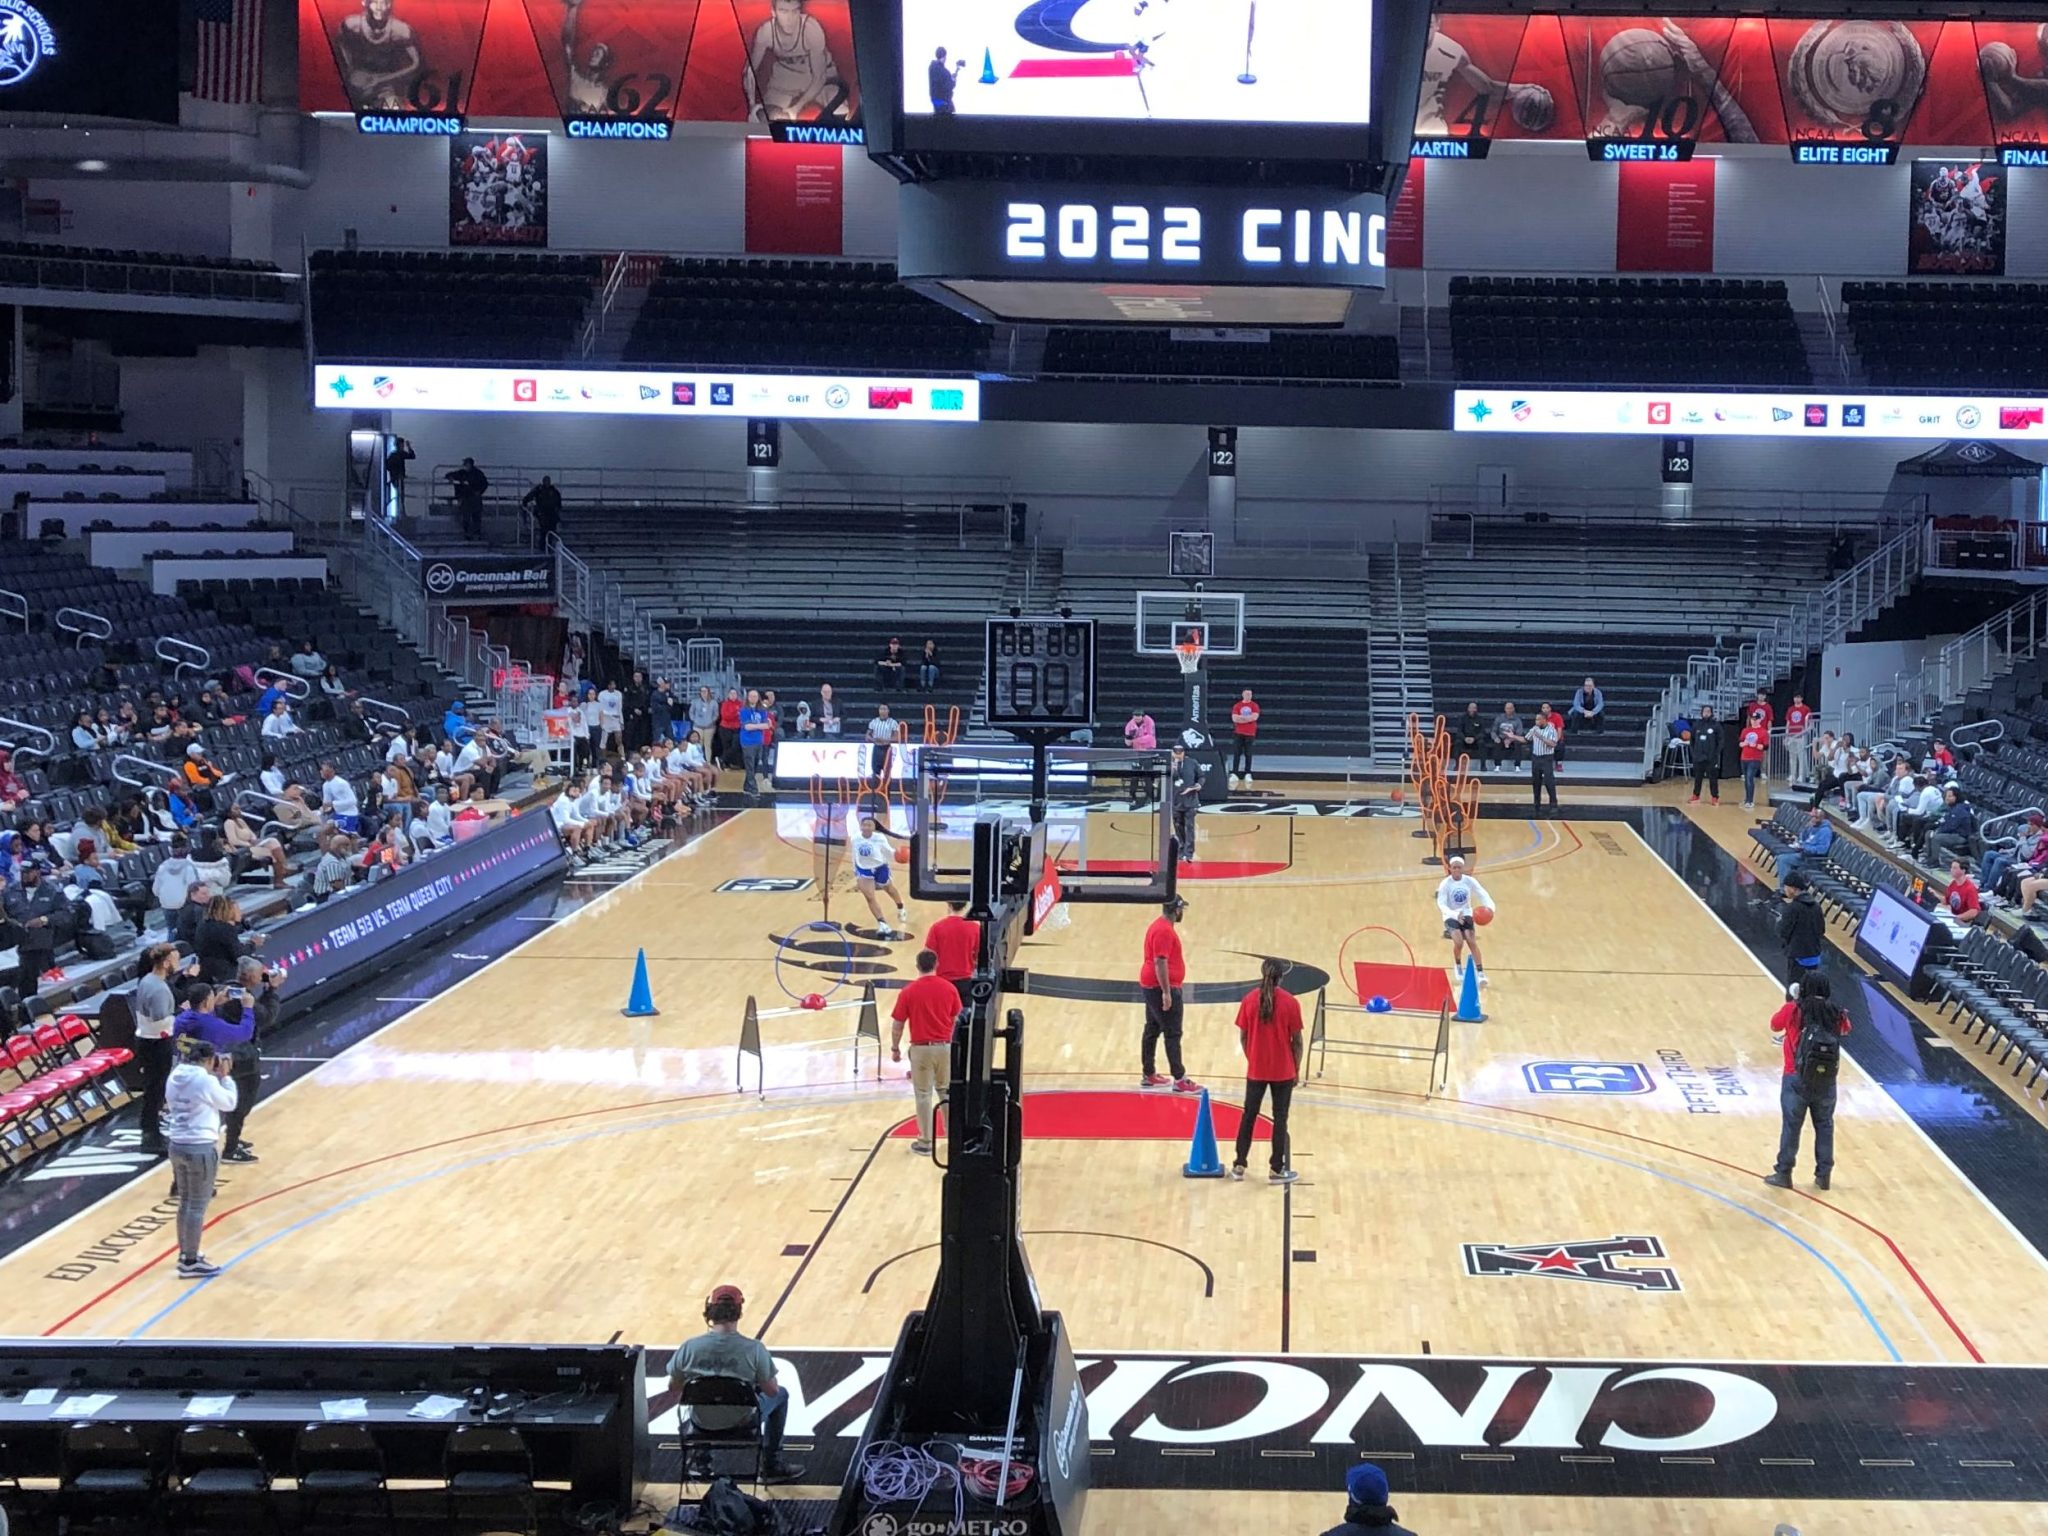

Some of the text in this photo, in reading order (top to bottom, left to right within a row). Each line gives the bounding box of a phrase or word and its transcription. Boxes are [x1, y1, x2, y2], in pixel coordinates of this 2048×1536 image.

[23, 5, 57, 55] SCHOOLS
[606, 73, 672, 116] 62
[360, 116, 460, 133] CHAMPIONS
[1862, 98, 1898, 140] 8
[568, 120, 668, 138] CHAMPIONS
[785, 126, 863, 142] TWYMAN
[1796, 128, 1836, 140] NCAA
[2001, 131, 2041, 142] NCAA
[1604, 144, 1678, 159] SWEET 16
[1800, 147, 1890, 163] ELITE EIGHT
[2003, 150, 2048, 165] FINAL
[1007, 203, 1201, 260] 2022
[787, 394, 810, 404] GRIT
[1919, 415, 1941, 424] GRIT
[754, 444, 772, 457] 121
[1213, 451, 1233, 464] 122
[1669, 458, 1689, 471] 123
[456, 570, 548, 582] Cincinnati Bell
[1191, 685, 1200, 723] Ameritas
[329, 875, 453, 948] TEAM 513 VS. TEAM QUEEN CITY
[1656, 1049, 1721, 1113] FIFTH THIRD
[1704, 1066, 1748, 1095] BANK
[44, 1263, 97, 1282] ED
